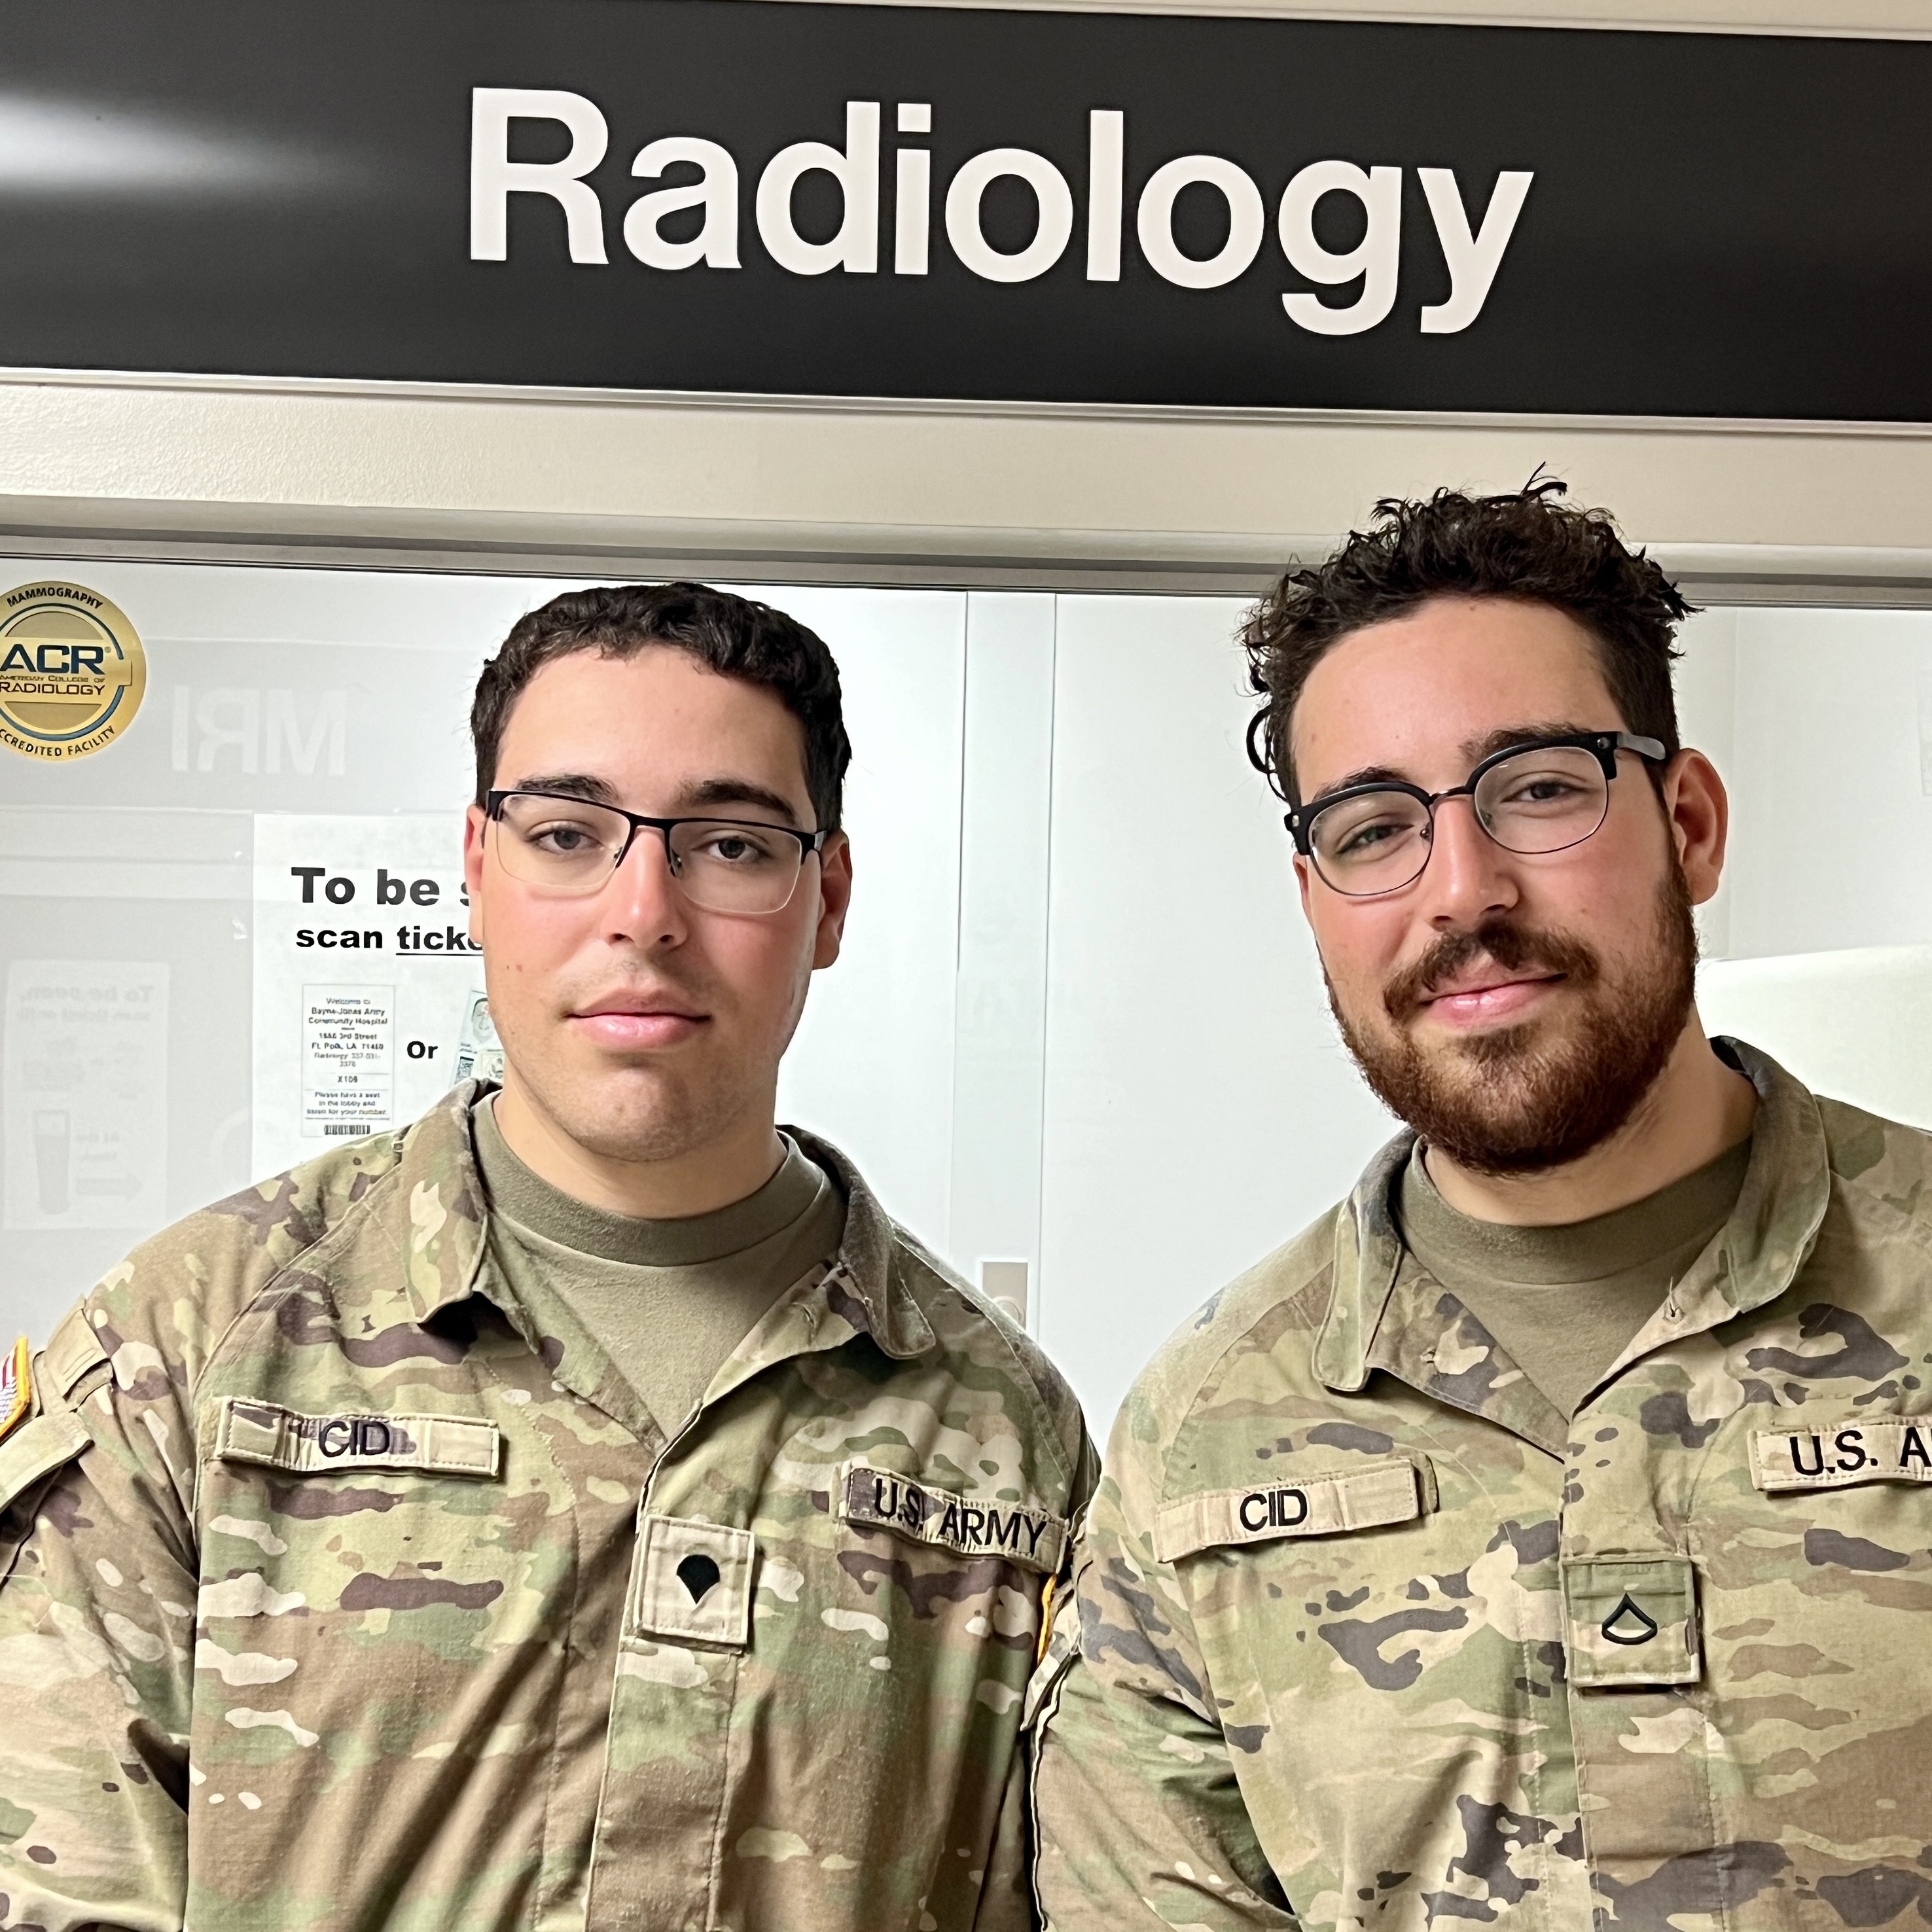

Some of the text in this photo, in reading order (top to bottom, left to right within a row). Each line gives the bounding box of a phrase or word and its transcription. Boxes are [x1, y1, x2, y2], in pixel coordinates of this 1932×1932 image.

[469, 87, 1534, 336] Radiology
[7, 587, 103, 609] MAMMOGRAPHY
[0, 643, 105, 675] ACR
[0, 681, 105, 696] RADIOLOGY
[0, 725, 115, 757] CCREDITED FACILITY
[291, 867, 355, 904] To
[376, 868, 440, 906] be
[296, 925, 484, 951] scan tick
[406, 1041, 438, 1060] Or
[318, 1421, 389, 1458] CID
[1789, 1426, 1932, 1476] U.S. A
[1240, 1489, 1308, 1531] CID
[939, 1501, 1046, 1555] ARMY
